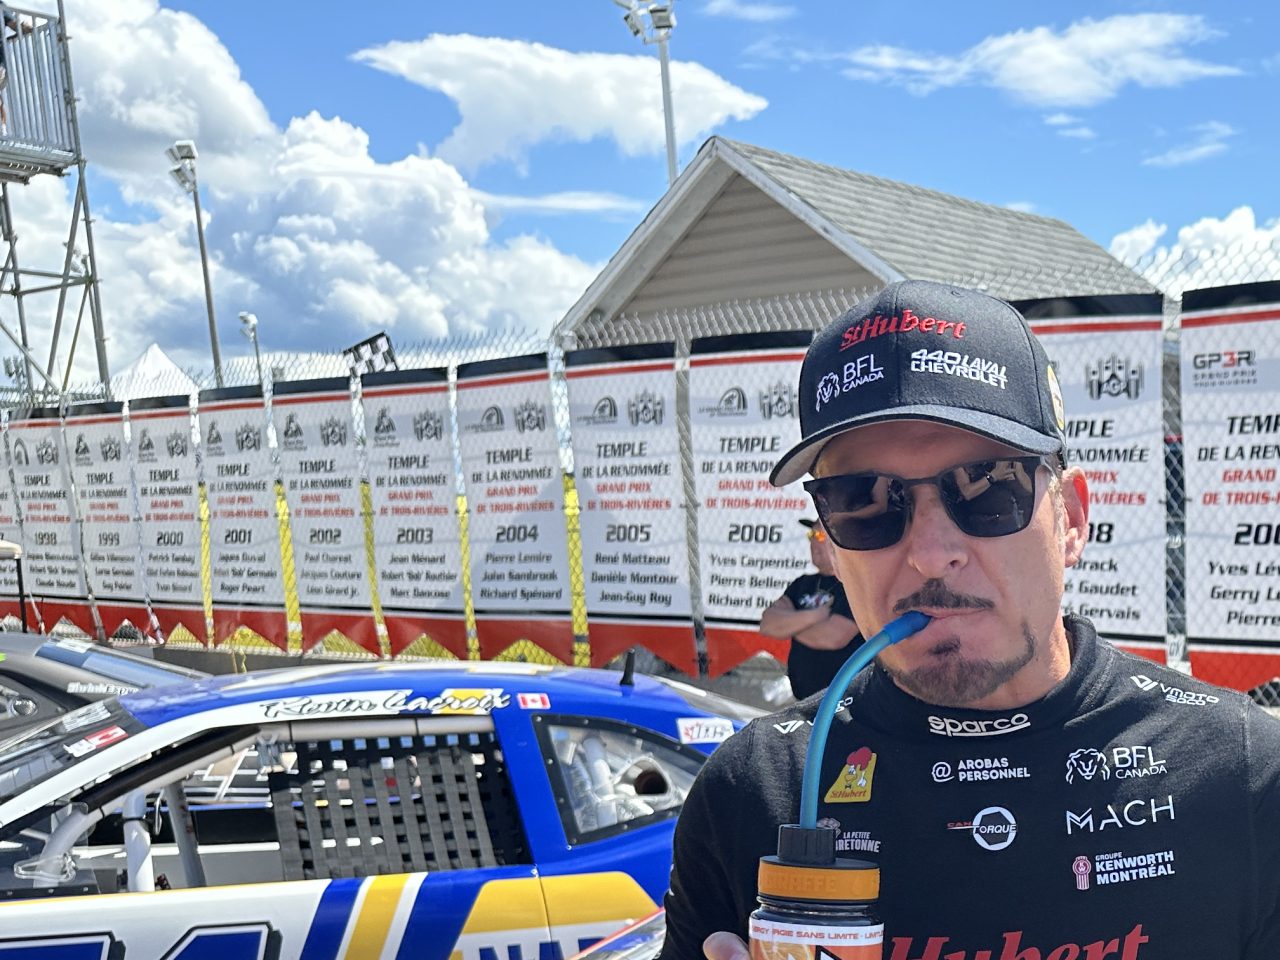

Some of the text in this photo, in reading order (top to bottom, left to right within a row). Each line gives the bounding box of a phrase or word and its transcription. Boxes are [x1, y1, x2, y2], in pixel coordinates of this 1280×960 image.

[843, 354, 884, 384] BFL
[911, 349, 1008, 378] 440 LAVAL
[843, 371, 884, 393] CANADA
[911, 360, 1008, 390] CHEVROLET
[596, 442, 647, 459] TEMPLE
[719, 436, 780, 453] TEMPLE
[1198, 447, 1219, 462] DE
[1224, 445, 1245, 461] LA
[1222, 468, 1277, 483] GRAND
[1202, 492, 1220, 506] DE
[156, 532, 184, 547] 2000
[224, 528, 253, 545] 2001
[309, 528, 341, 544] 2002
[396, 527, 434, 544] 2003
[496, 525, 539, 544] 2004
[606, 524, 652, 543] 2005
[728, 524, 784, 544] 2006
[1208, 561, 1249, 577] Yves
[1079, 580, 1139, 597] Gaudet
[1211, 586, 1260, 604] Gerry
[1079, 604, 1141, 620] Gervais
[260, 696, 377, 720] Kevin
[928, 713, 1029, 736] sparco
[958, 757, 1009, 770] AROBAS
[1113, 746, 1166, 768] BFL
[959, 767, 1031, 782] PERSONNEL
[1115, 765, 1168, 780] CANADA
[1066, 795, 1176, 835] MACH
[1095, 852, 1123, 860] GROUPE
[1095, 851, 1175, 872] KENWORTH
[1096, 862, 1176, 885] MONTRÉAL
